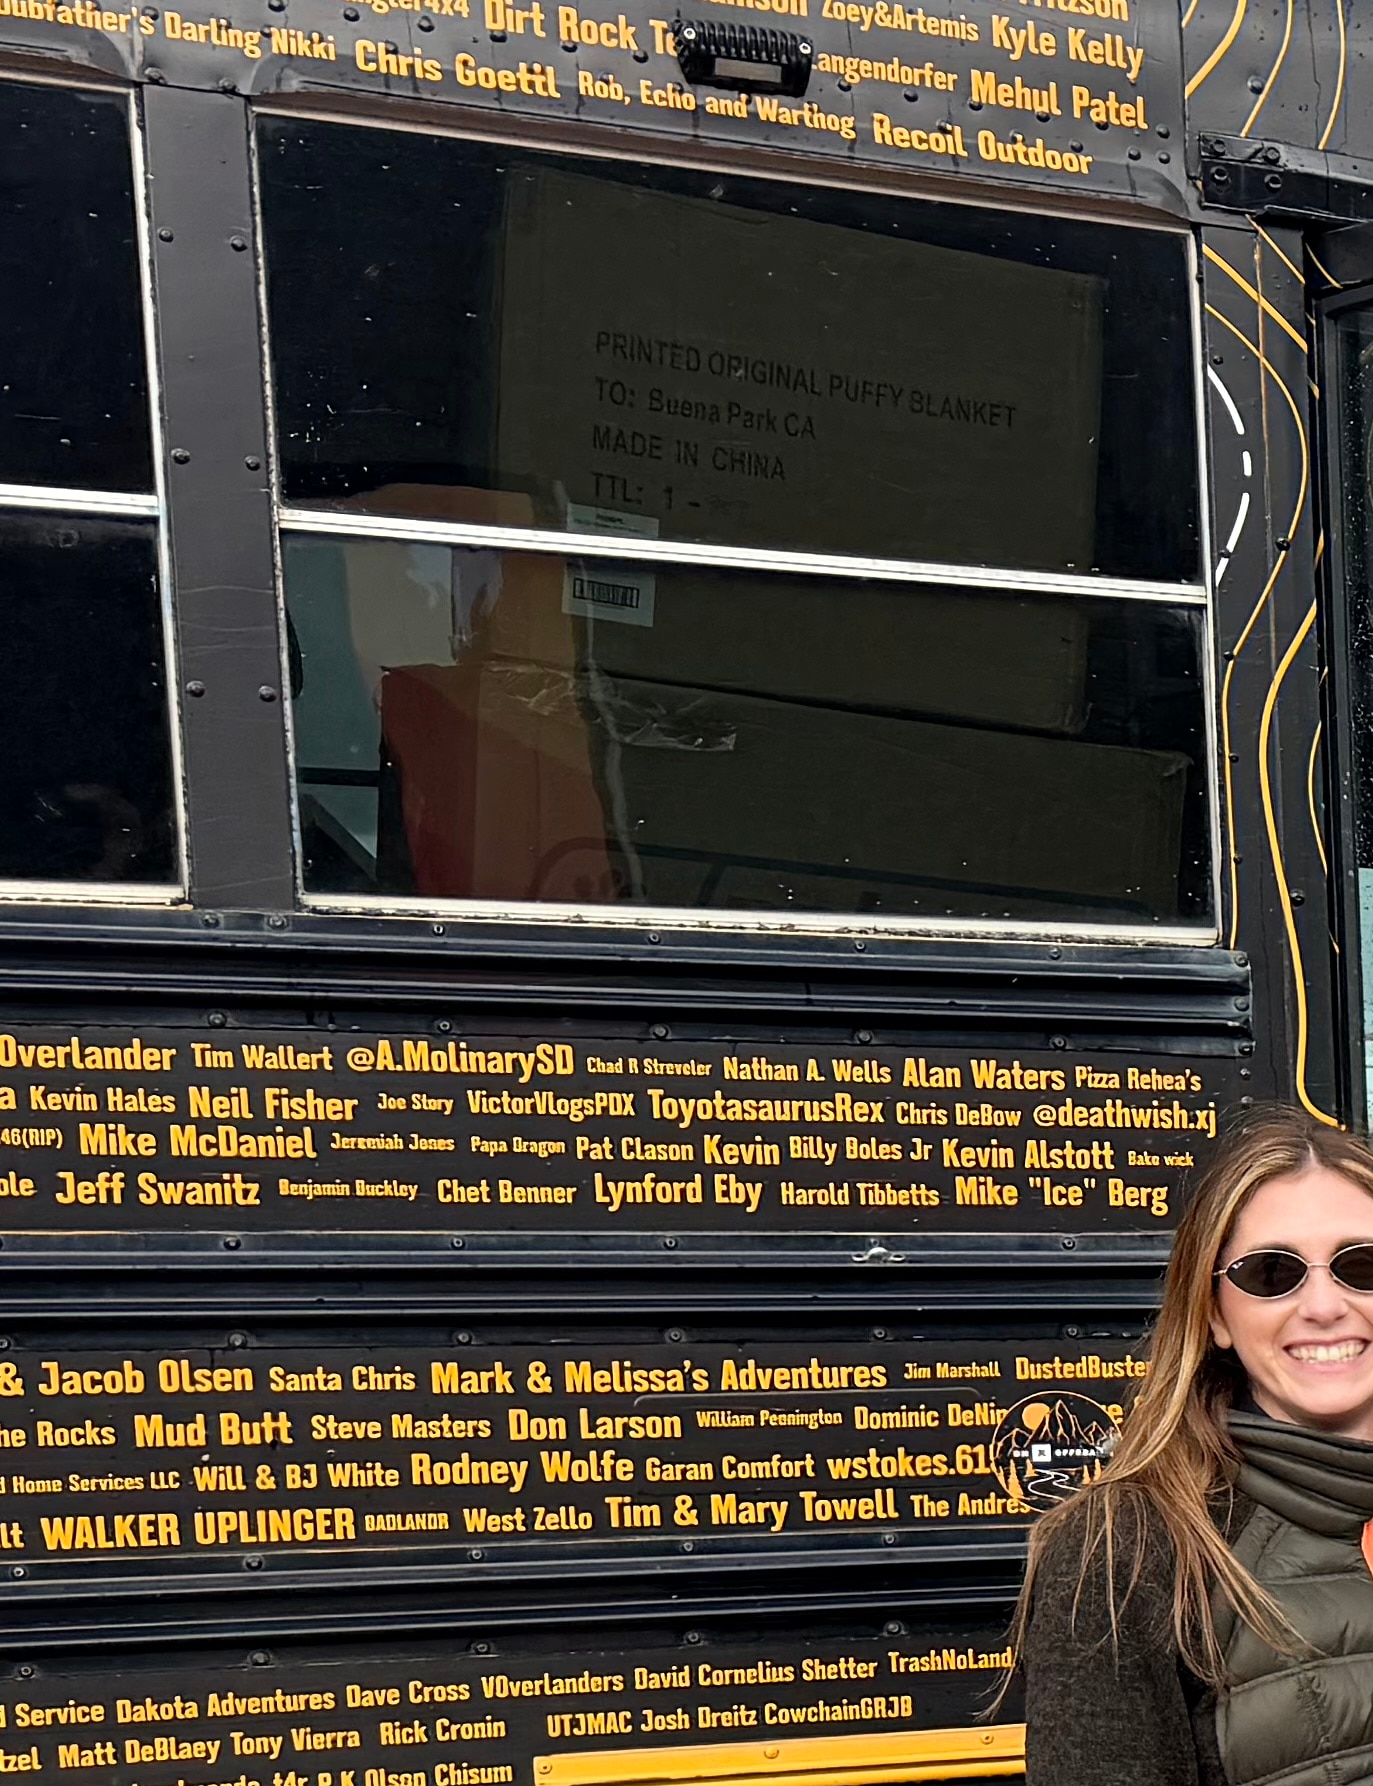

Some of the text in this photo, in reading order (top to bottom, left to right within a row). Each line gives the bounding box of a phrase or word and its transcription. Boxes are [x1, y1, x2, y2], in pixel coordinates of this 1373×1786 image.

[992, 16, 1143, 82] Kyle Kelly
[355, 40, 1092, 174] Chris Recoil Outdoor
[971, 70, 1148, 129] Mehul Patel
[595, 331, 701, 374] PRINTED
[828, 373, 904, 409] PUFFY
[908, 389, 1018, 429] BLANKET
[648, 388, 721, 424] Buena
[727, 404, 778, 433] Park
[784, 412, 817, 440] CA
[592, 424, 787, 481] MADE IN CHINA
[192, 1043, 1065, 1090] Tim Wallert Chad Nathan Alan Waters
[30, 1087, 97, 1111] Kevin
[189, 1087, 253, 1118] Neil
[265, 1088, 358, 1120] Fisher
[379, 1096, 406, 1109] Joe
[896, 1102, 947, 1125] Chris
[80, 1123, 1114, 1169] Mike McDaniel Papa Pat Kevin Kevin Alstott
[56, 1172, 124, 1204] Jeff
[138, 1173, 260, 1205] Swanitz
[438, 1179, 491, 1202] Chet
[595, 1173, 702, 1211] Lynford
[715, 1174, 762, 1212] Eby
[781, 1184, 849, 1205] Harold
[955, 1176, 1018, 1205] Mike
[1109, 1179, 1168, 1216] Berg
[39, 1360, 1000, 1395] Jacob Olsen Santa Mark Adventures Jim Marshall
[37, 1420, 115, 1446] Rocks
[135, 1414, 206, 1447] Mud
[220, 1412, 293, 1445] Butt
[311, 1415, 381, 1439] Steve
[392, 1414, 491, 1438] Masters
[509, 1409, 566, 1440] Don
[580, 1408, 681, 1439] Larson
[696, 1411, 754, 1427] William
[13, 1450, 633, 1493] Home Services LLC White Rodney Wolfe
[41, 1488, 949, 1550] WALKER UPLINGER West Zello Tim Mary Towell The
[117, 1666, 690, 1723] Dakota Dave Cross David
[59, 1743, 116, 1768] Matt
[231, 1732, 282, 1759] Tony
[380, 1721, 427, 1745] Rick
[641, 1709, 689, 1731] Josh
